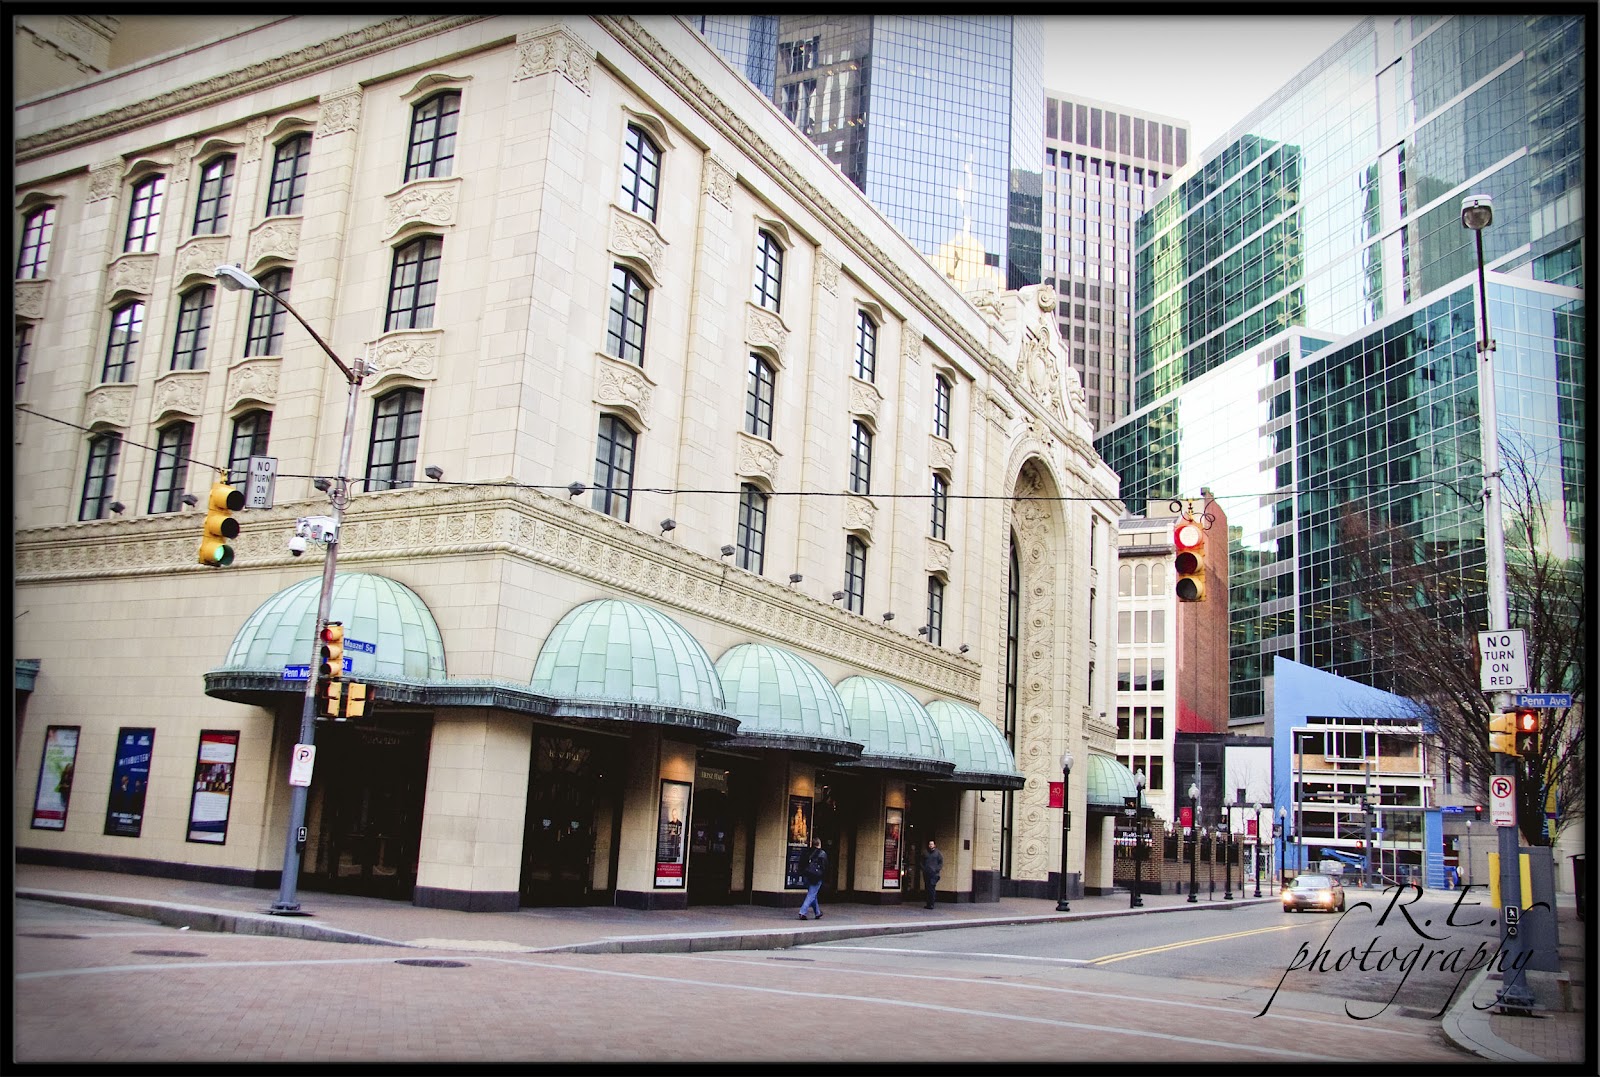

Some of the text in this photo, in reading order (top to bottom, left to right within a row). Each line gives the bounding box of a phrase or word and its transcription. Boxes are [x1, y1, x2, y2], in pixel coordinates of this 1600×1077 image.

[257, 461, 270, 471] NO
[254, 474, 270, 482] TURN
[256, 485, 266, 493] ON
[253, 496, 266, 504] RED
[1486, 635, 1511, 648] NO
[1484, 650, 1515, 660] TURN
[283, 668, 311, 678] Penn Ave
[1492, 663, 1509, 673] ON
[1490, 676, 1513, 685] RED
[1521, 696, 1567, 706] Penn Ave
